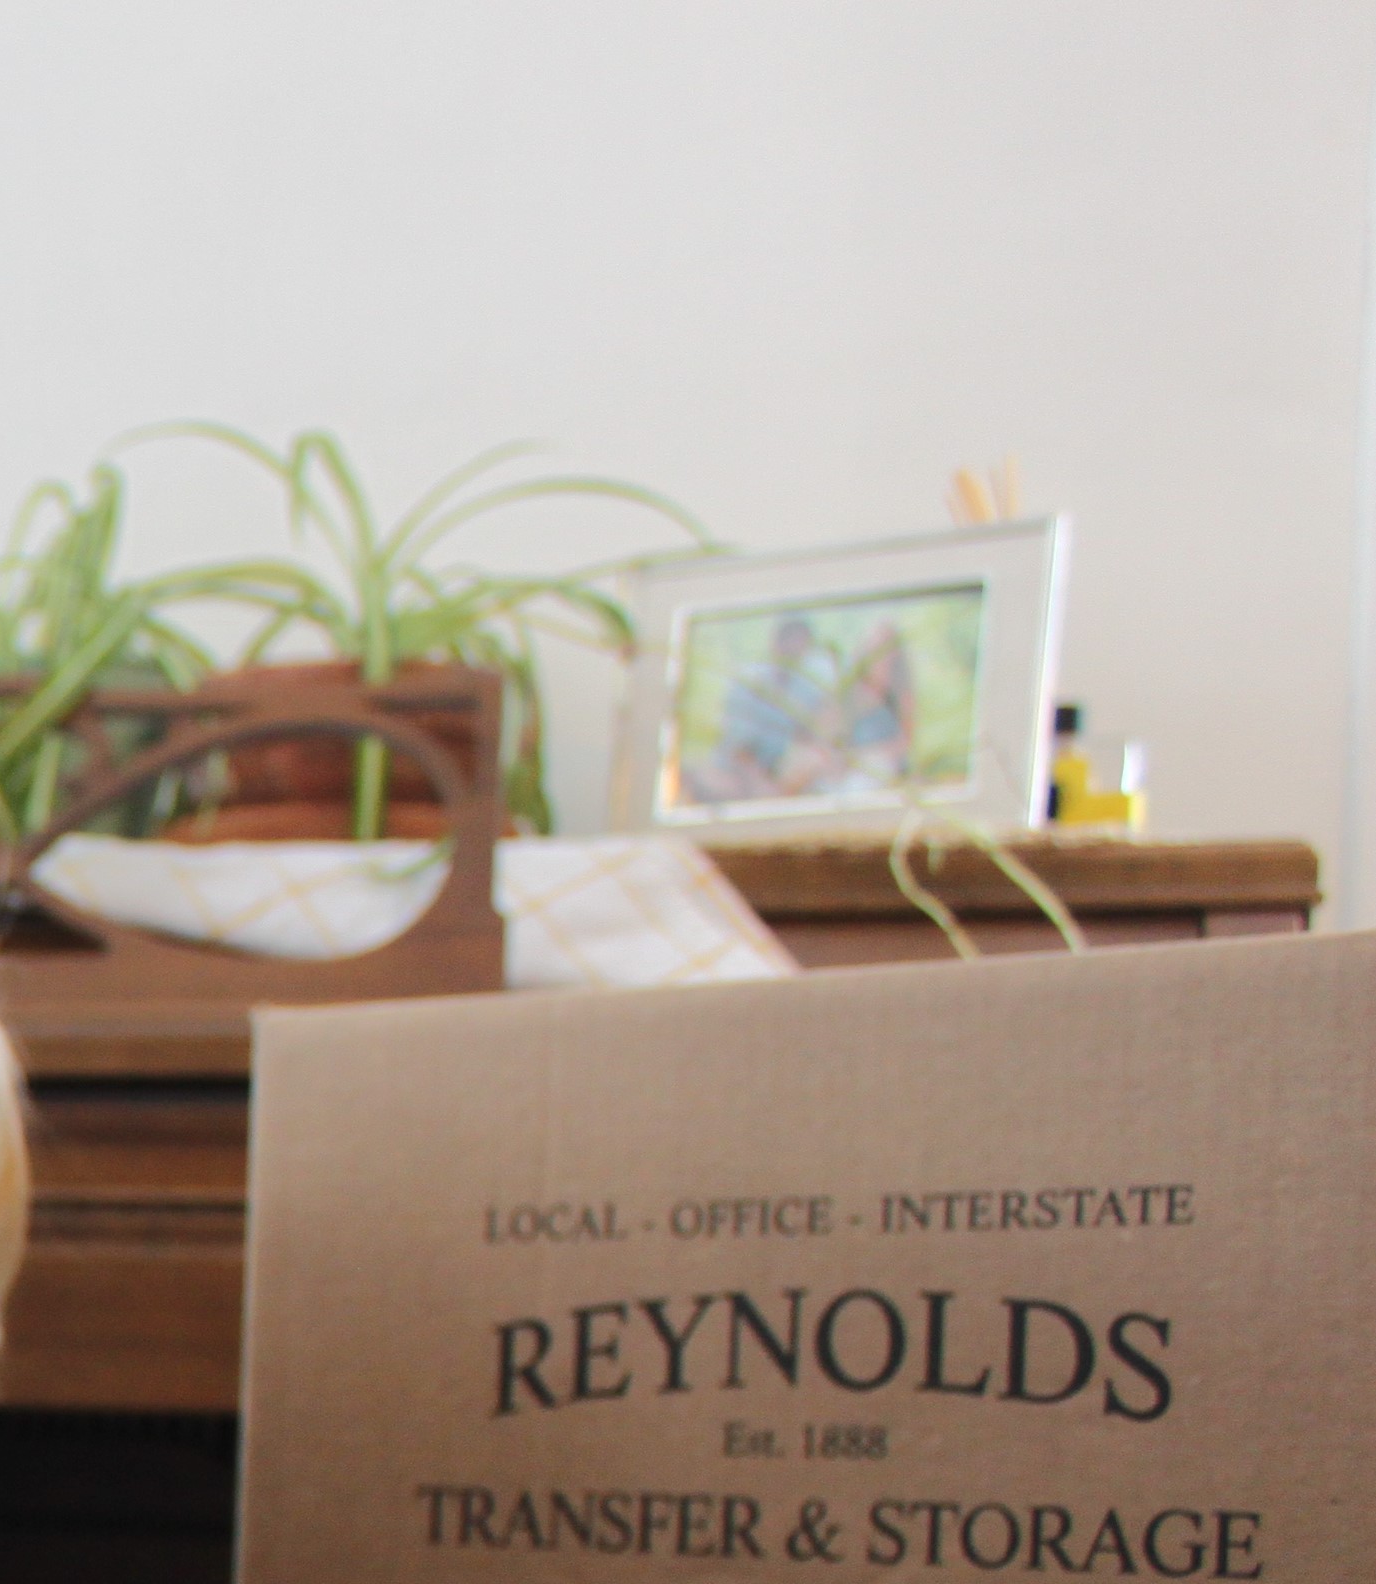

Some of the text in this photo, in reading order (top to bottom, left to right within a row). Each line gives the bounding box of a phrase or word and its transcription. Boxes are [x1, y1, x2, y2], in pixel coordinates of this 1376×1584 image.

[485, 1203, 625, 1245] LOCAL
[669, 1195, 835, 1240] OFFICE
[881, 1183, 1195, 1235] INTERSTATE
[490, 1289, 1173, 1423] REYNOLDS
[723, 1423, 887, 1460] Est. 1888
[418, 1484, 1264, 1581] TRANSFER & STORAGE
